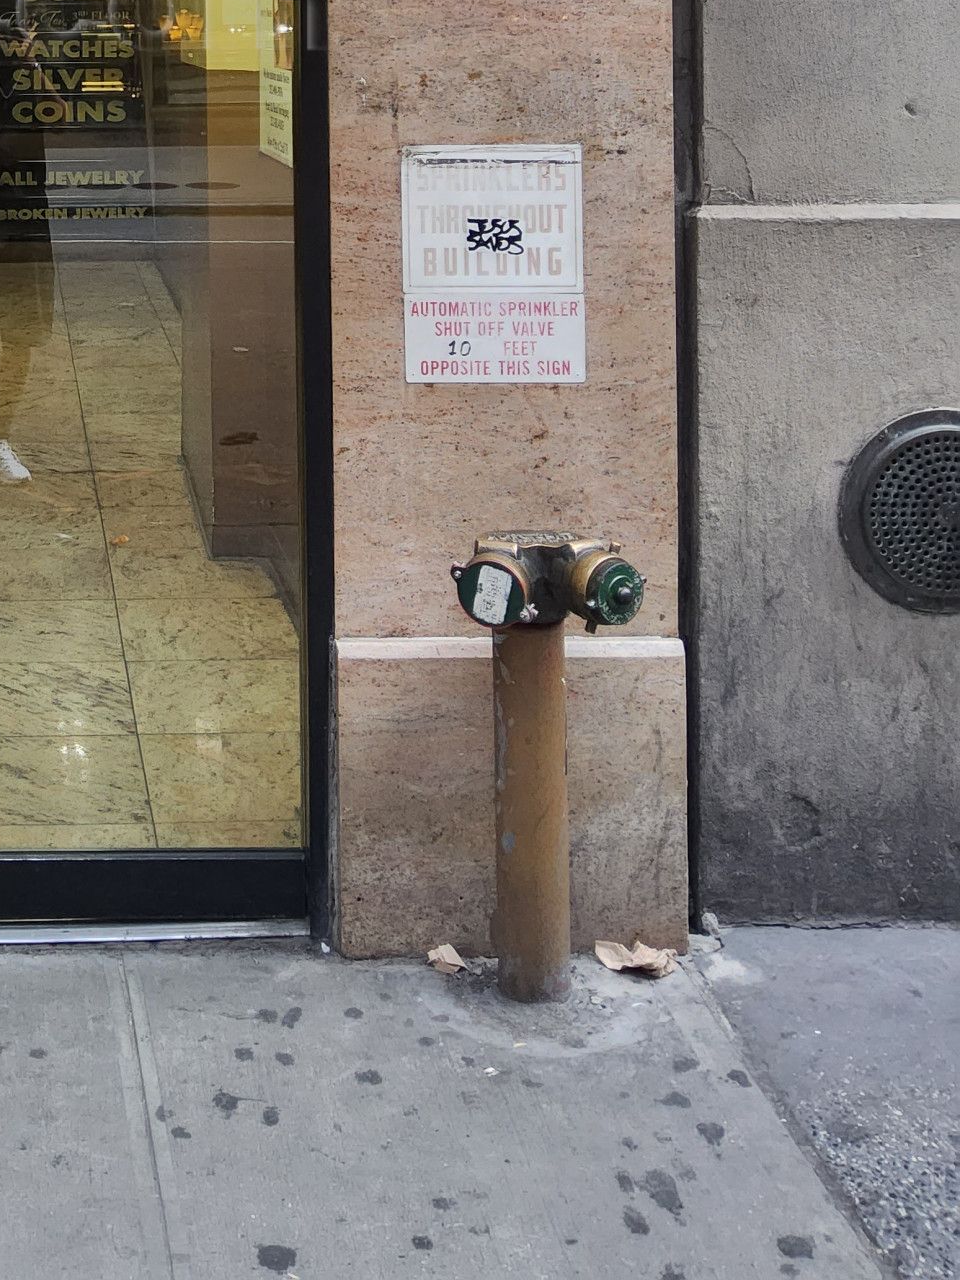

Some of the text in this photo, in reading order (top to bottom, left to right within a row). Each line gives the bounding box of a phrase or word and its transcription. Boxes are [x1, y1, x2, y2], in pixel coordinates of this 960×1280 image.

[0, 39, 135, 59] WATCHES
[11, 68, 124, 92] SILVER
[11, 100, 127, 124] COINS
[43, 169, 145, 186] JEWELRY
[72, 206, 148, 220] JEWELRY
[410, 301, 579, 317] AUTOMATIC SPRINKLER
[434, 321, 556, 337] SHUT OFF VALVE
[448, 340, 472, 357] 10
[503, 340, 538, 356] FEET
[420, 360, 571, 376] OPPOSITE THIS SIGN
